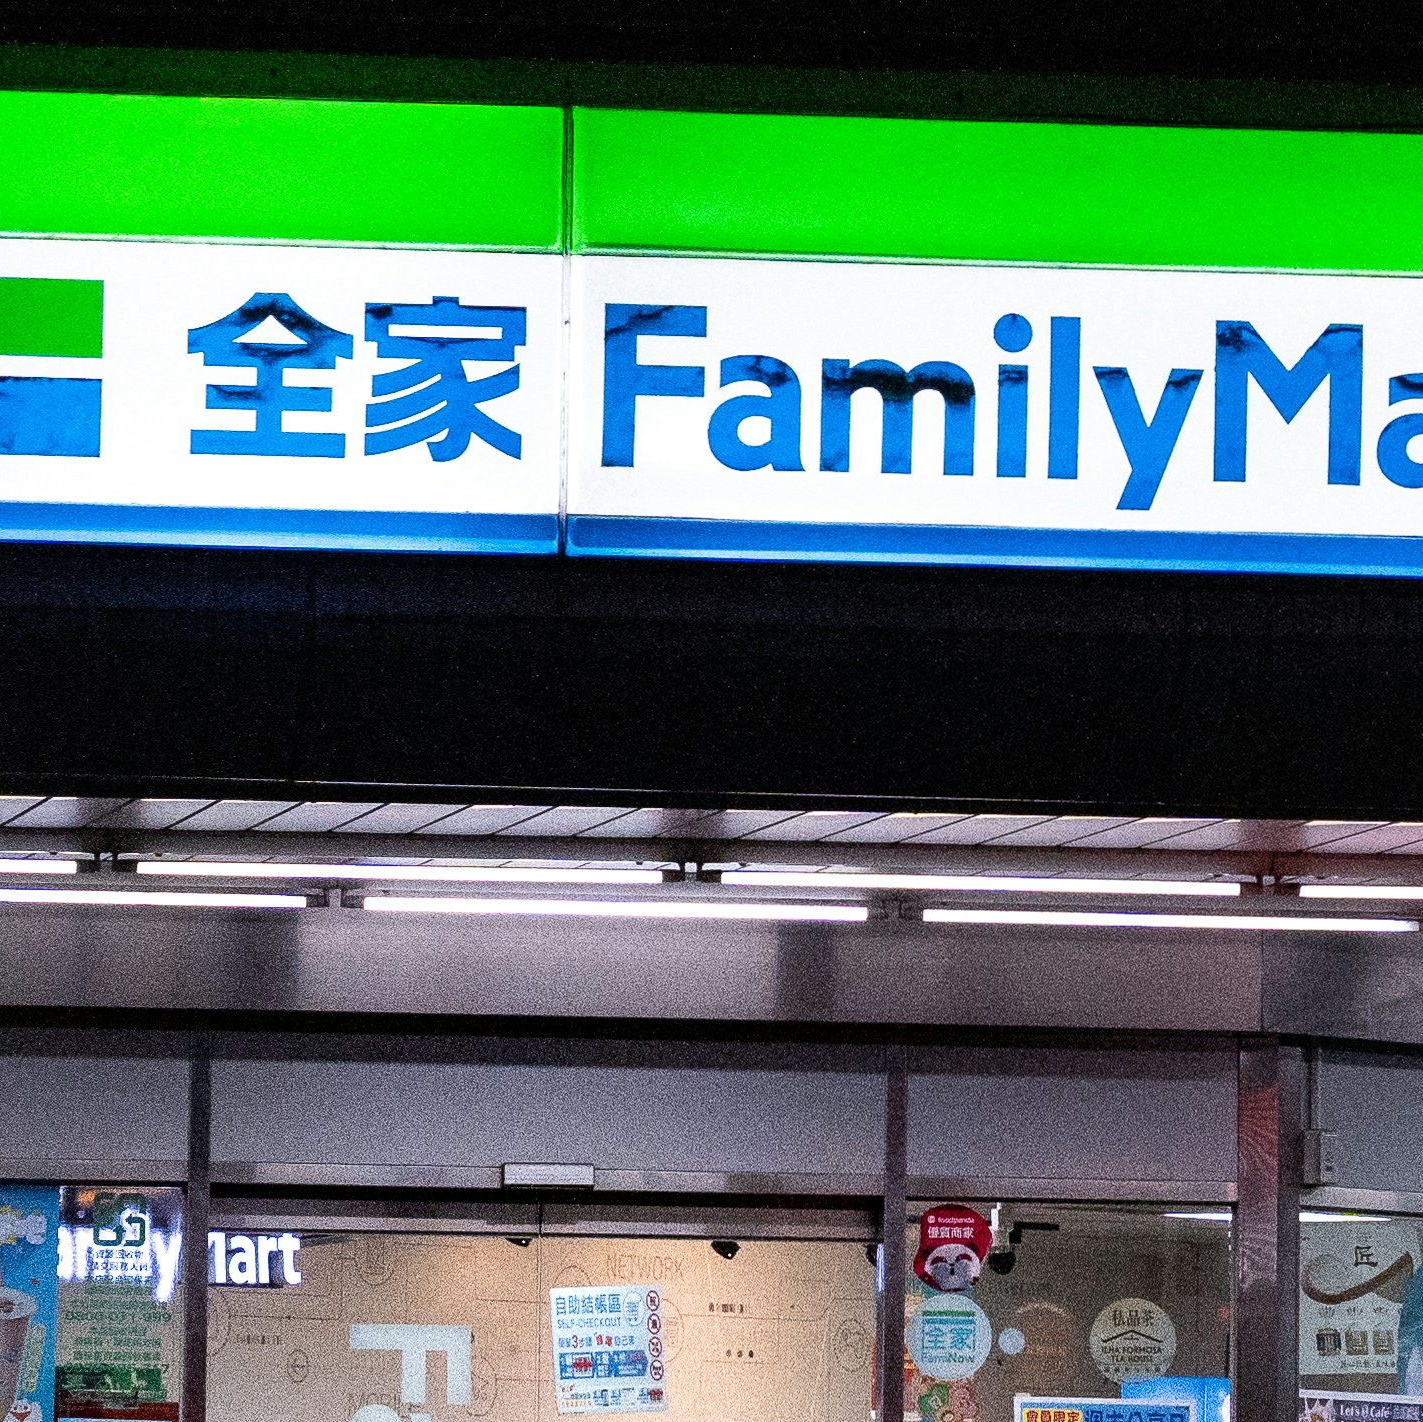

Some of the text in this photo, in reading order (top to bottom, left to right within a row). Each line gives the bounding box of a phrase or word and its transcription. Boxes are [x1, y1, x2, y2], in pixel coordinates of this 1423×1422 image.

[186, 292, 528, 462] 全家
[937, 1215, 976, 1225] foodpanda
[927, 1226, 975, 1239] 優質商家
[924, 1326, 973, 1351] 全家
